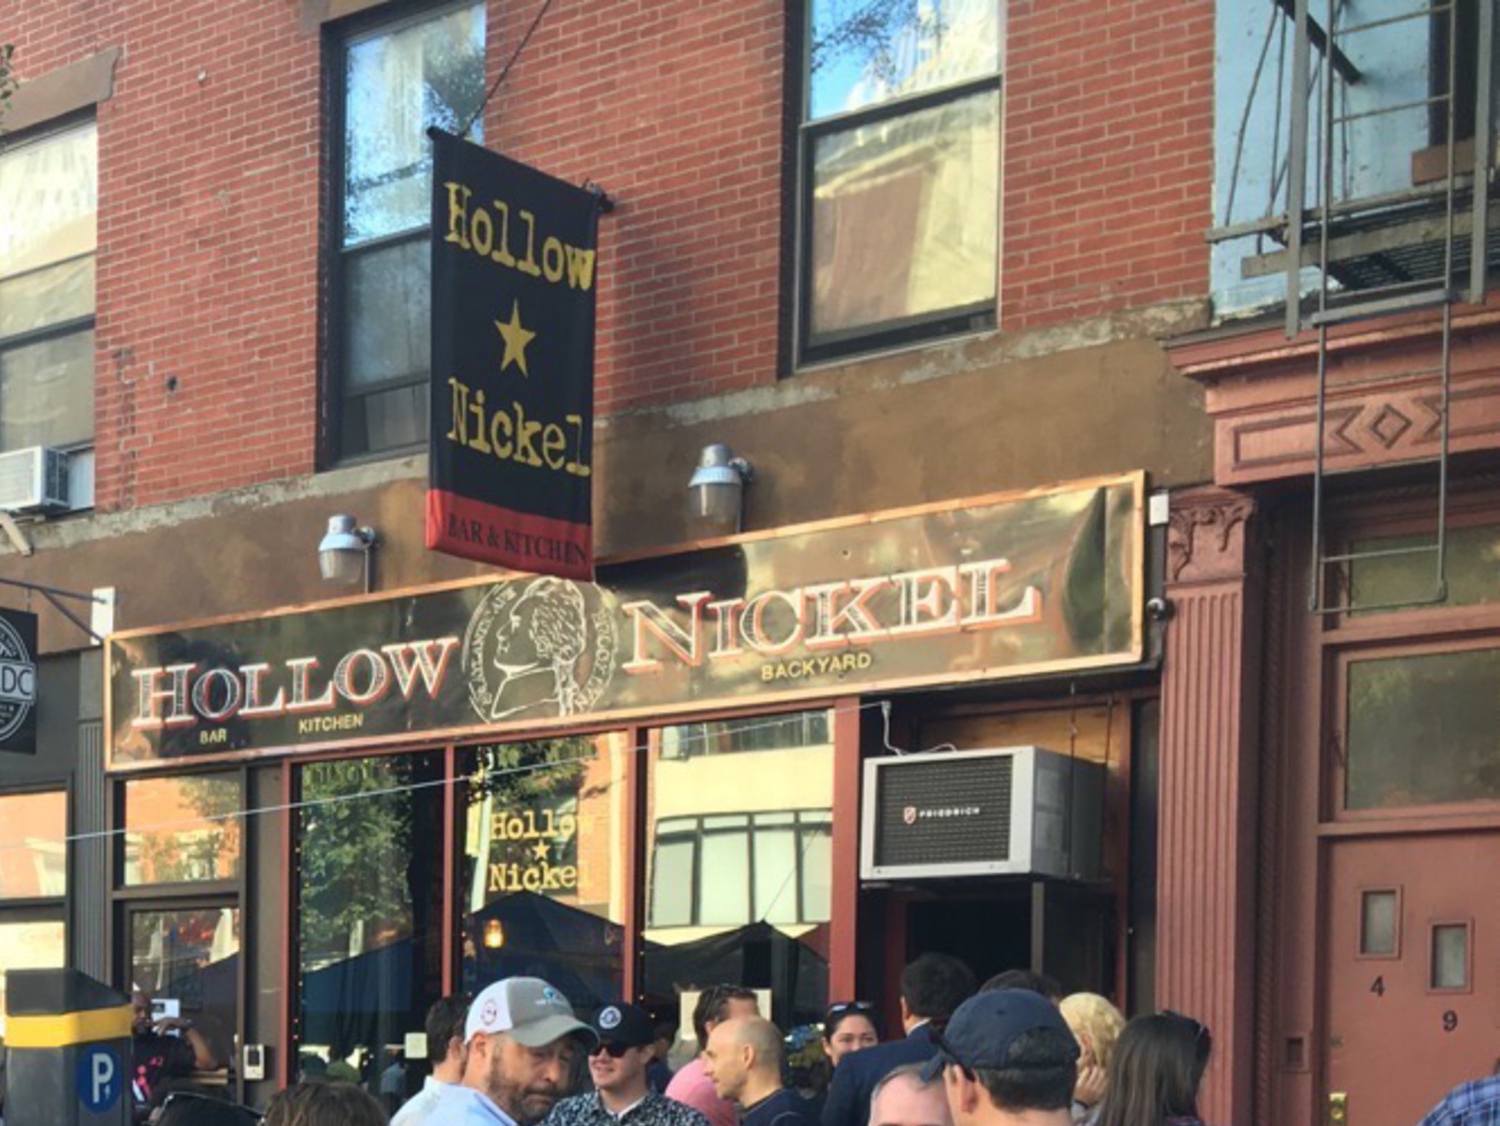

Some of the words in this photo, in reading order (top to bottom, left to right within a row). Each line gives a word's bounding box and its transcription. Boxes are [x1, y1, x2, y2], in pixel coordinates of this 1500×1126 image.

[444, 181, 595, 291] Hollow
[446, 376, 591, 477] Nickel
[448, 513, 482, 544] BAR
[487, 524, 498, 548] &
[504, 530, 587, 564] KITCHEN
[130, 635, 460, 729] HOLLOW
[622, 558, 1042, 675] NICKEL
[200, 728, 227, 744] BAR
[298, 713, 364, 734] KITCHEN
[761, 651, 872, 682] BACKYARD
[1370, 975, 1385, 997] 4
[1442, 1010, 1458, 1032] 9
[92, 1053, 114, 1104] P
